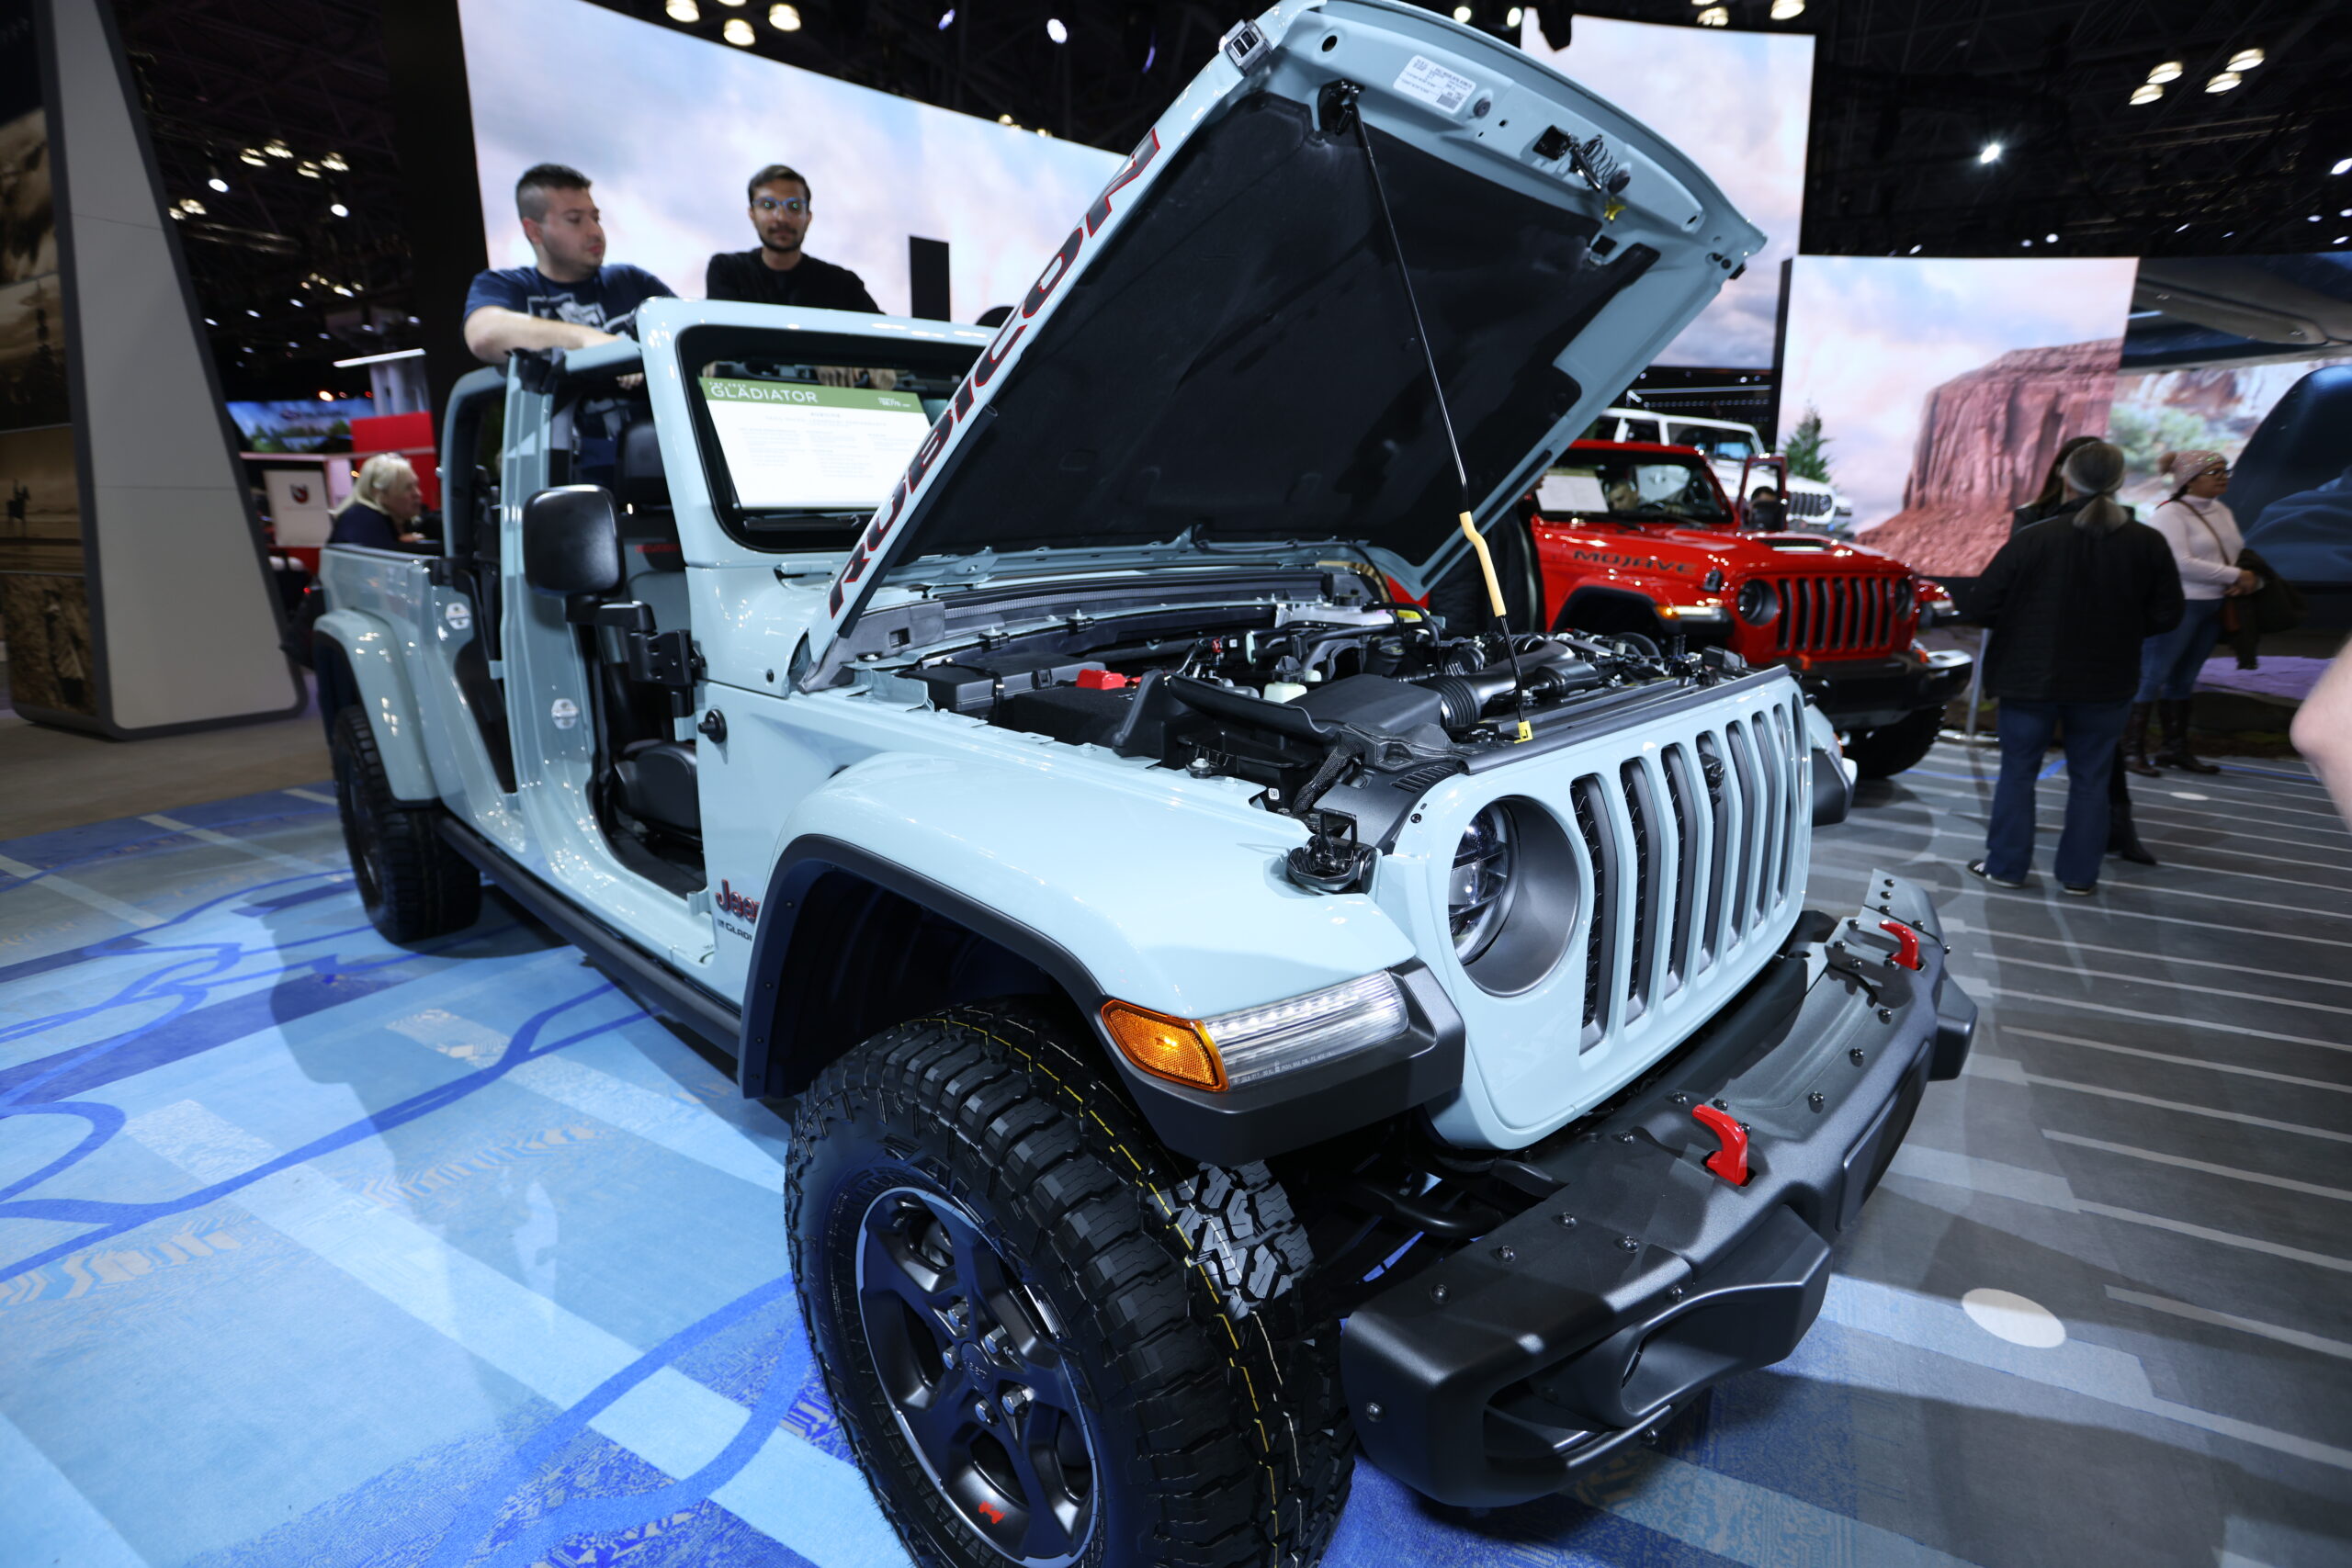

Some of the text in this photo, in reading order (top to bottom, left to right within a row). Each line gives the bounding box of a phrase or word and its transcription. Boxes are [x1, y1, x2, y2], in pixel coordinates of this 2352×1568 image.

[830, 128, 1161, 619] RUBICON
[710, 385, 818, 402] GLADIATOR
[1574, 549, 1697, 575] MOJAVE
[715, 879, 761, 924] Jee
